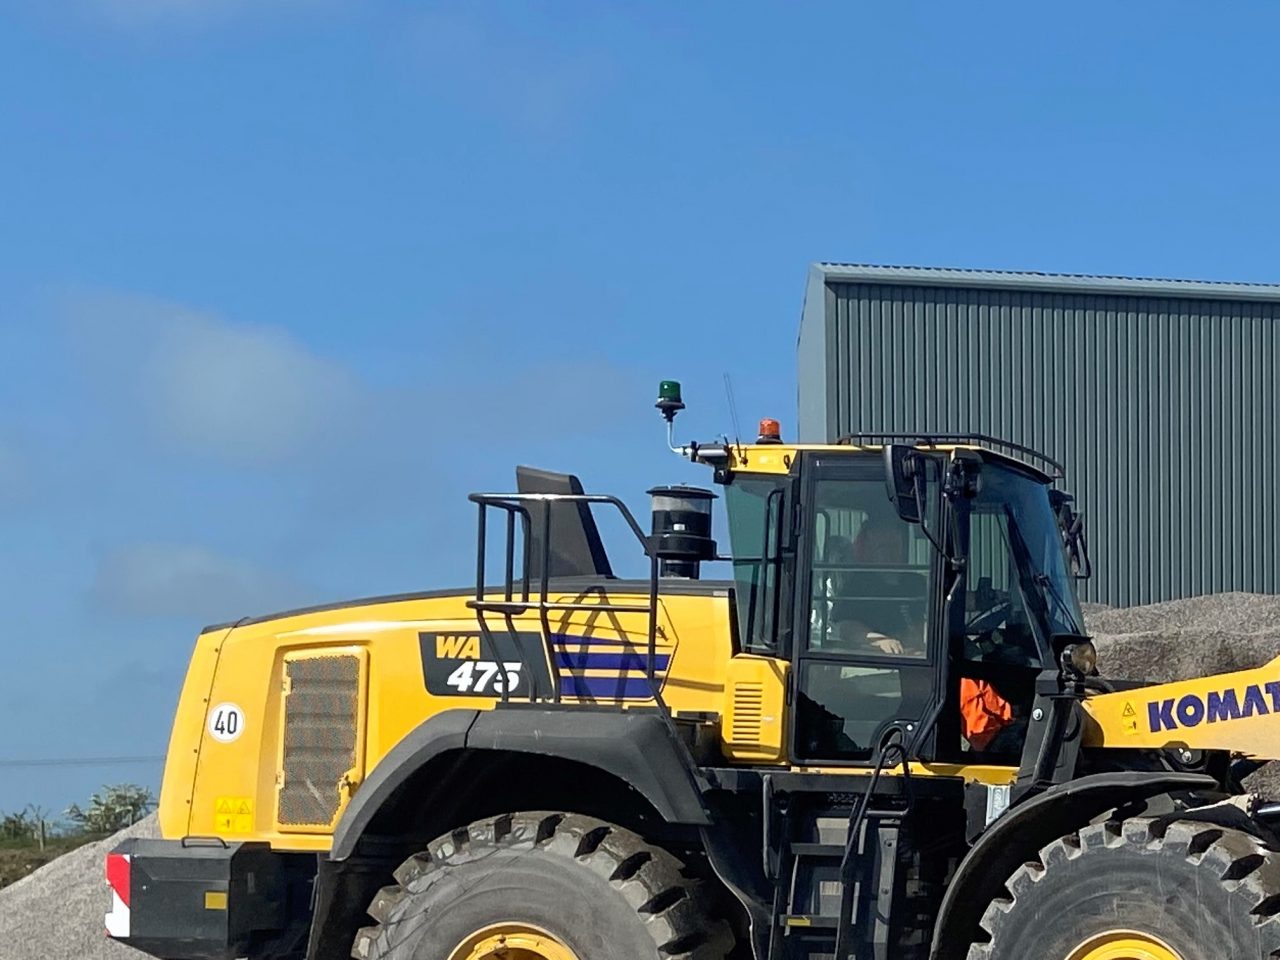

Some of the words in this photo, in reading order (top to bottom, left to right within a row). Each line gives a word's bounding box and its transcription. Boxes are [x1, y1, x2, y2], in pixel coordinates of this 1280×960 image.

[436, 636, 480, 659] WA
[447, 661, 522, 693] 475
[214, 711, 238, 734] 40
